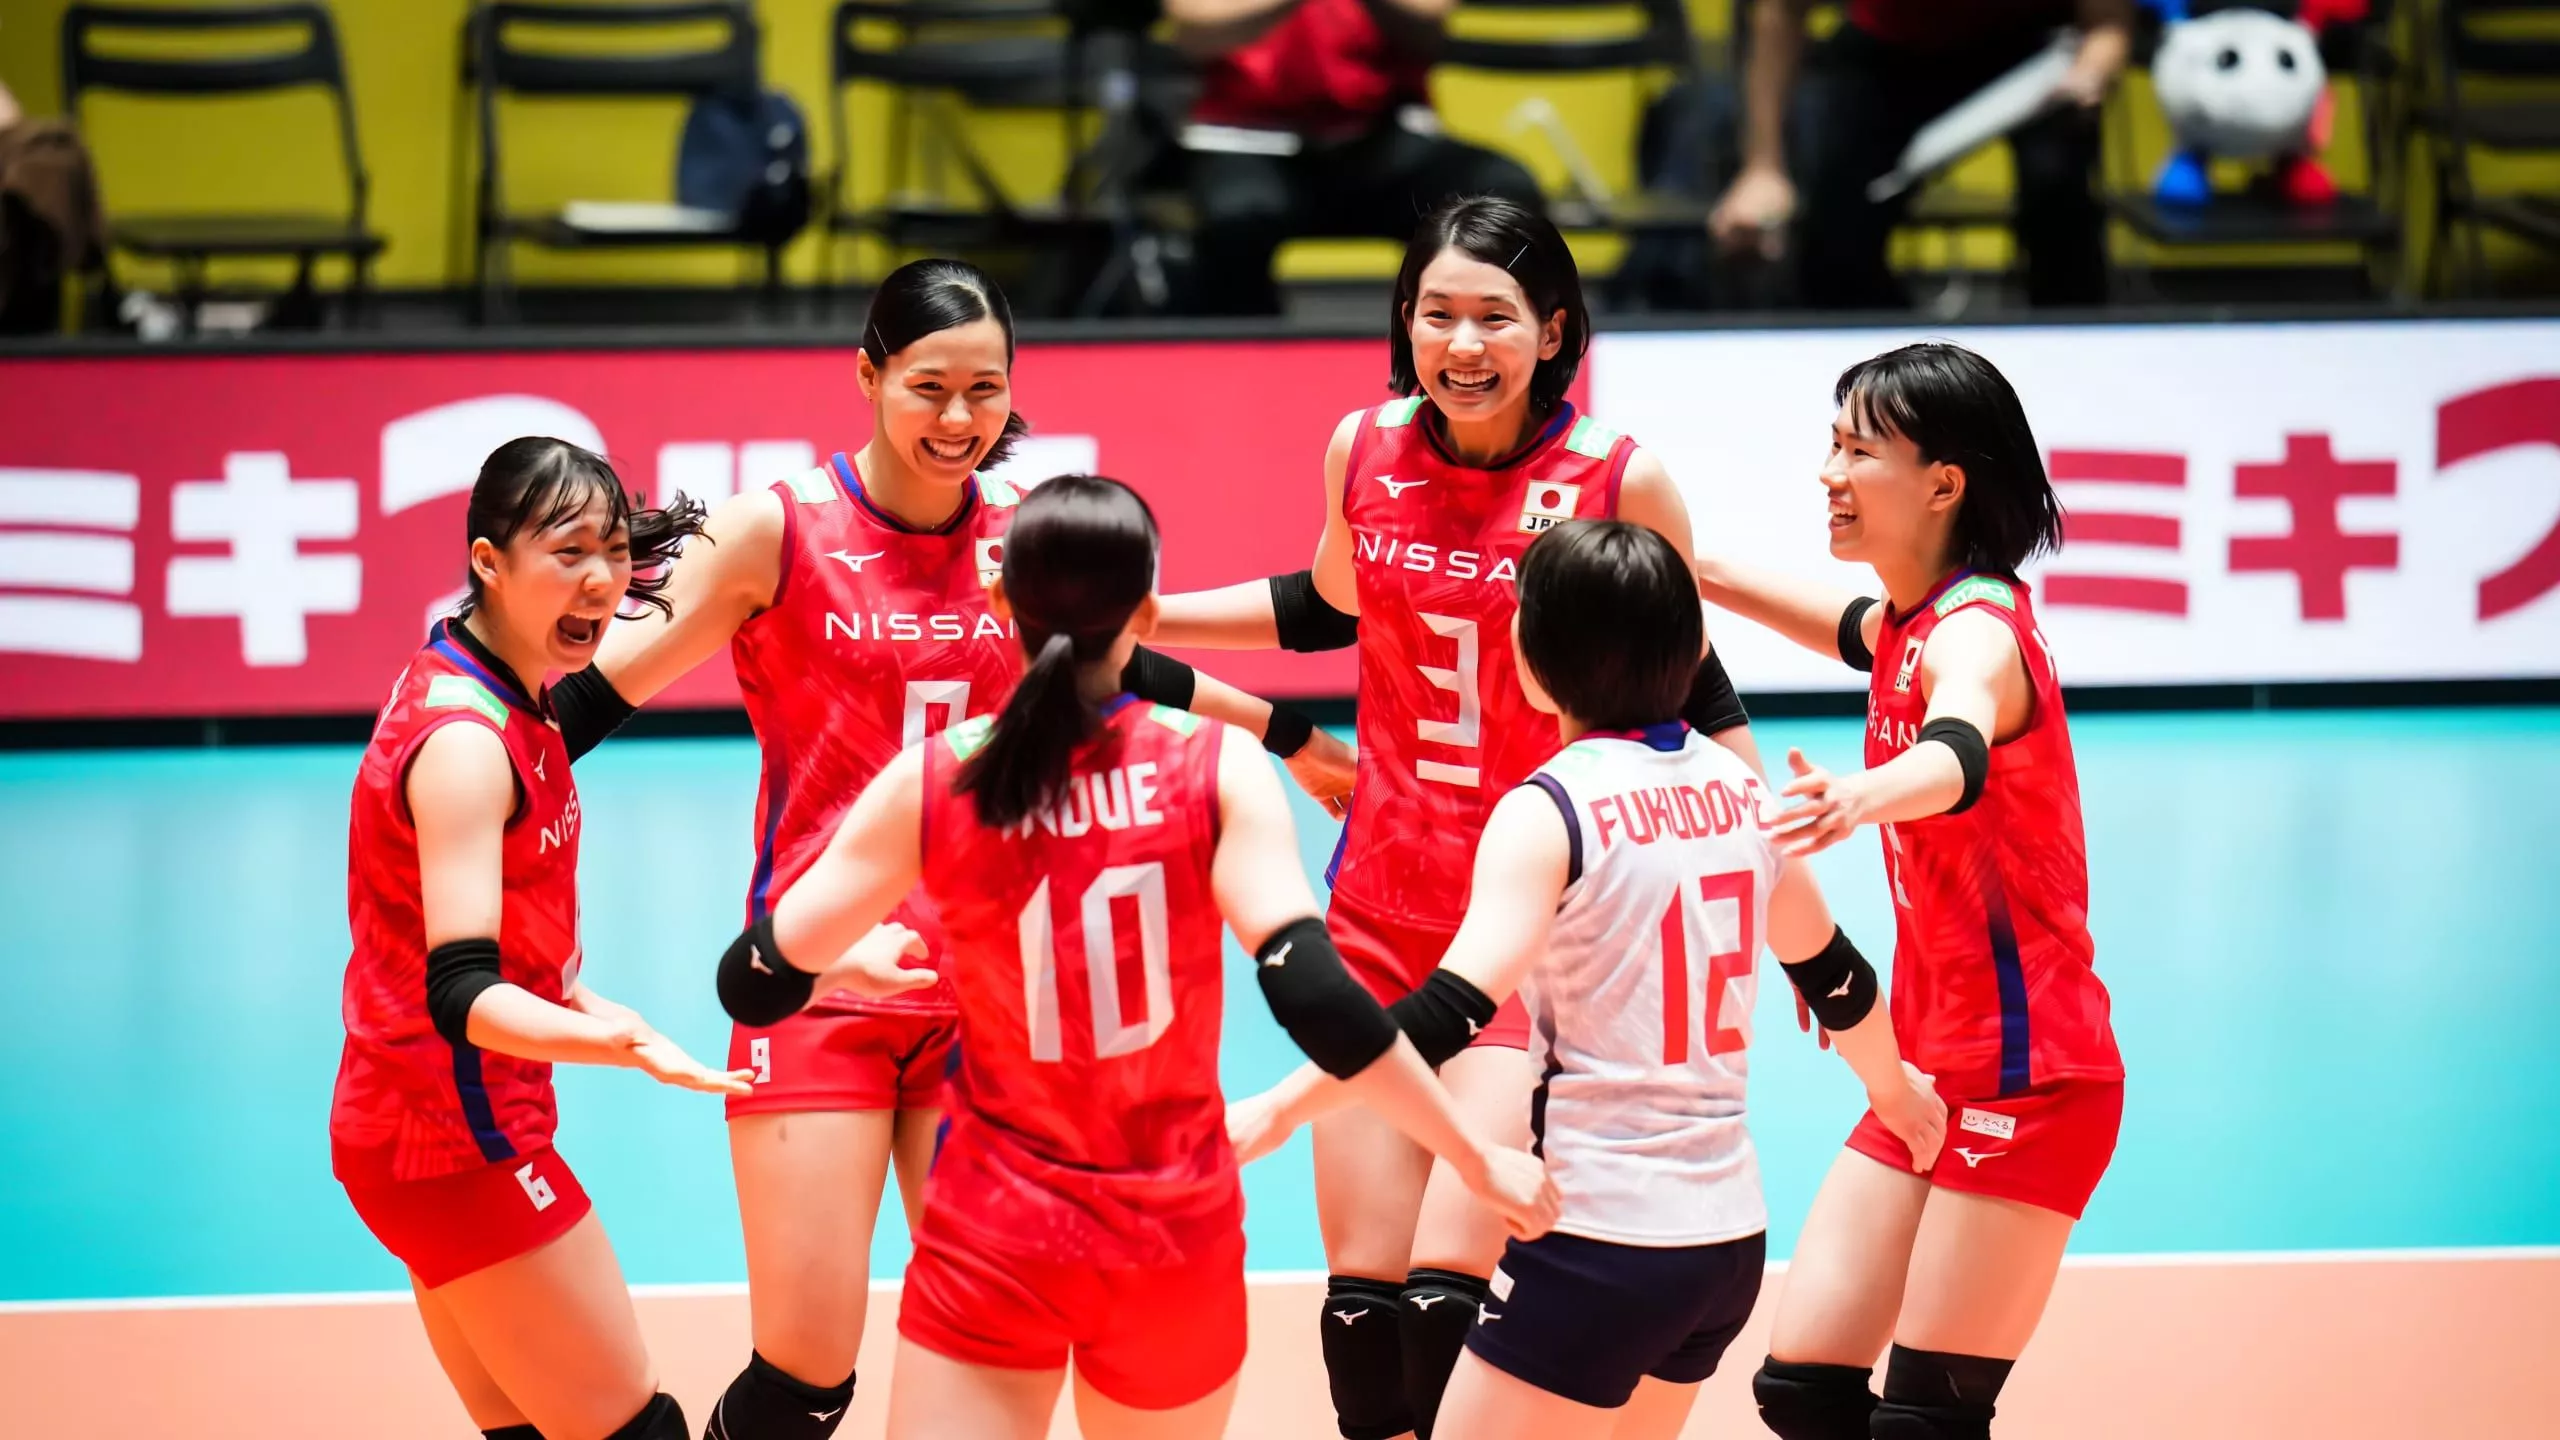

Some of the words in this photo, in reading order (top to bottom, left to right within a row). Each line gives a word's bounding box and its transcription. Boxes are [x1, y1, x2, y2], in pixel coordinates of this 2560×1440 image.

[1356, 532, 1516, 582] NISSA
[1526, 517, 1559, 530] JP
[1415, 611, 1481, 748] 3
[538, 788, 579, 855] NISS
[1588, 778, 1776, 851] FUKUDOME
[1017, 861, 1175, 1063] 10
[1660, 869, 1754, 1066] 12
[750, 1037, 771, 1084] 9
[514, 1161, 557, 1212] 6
